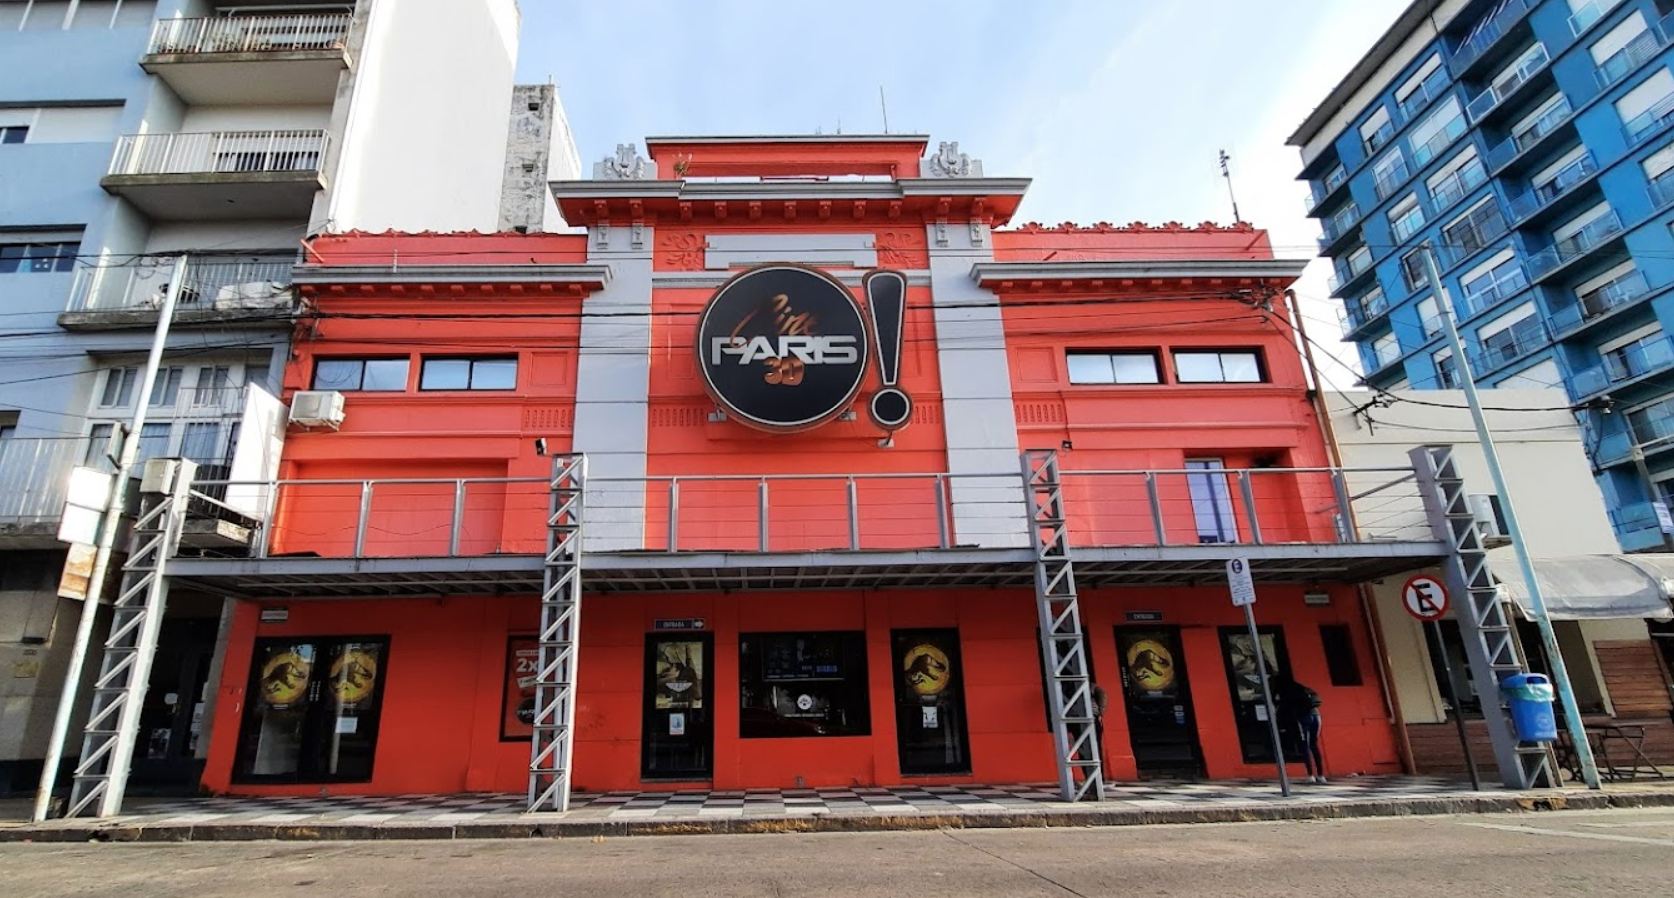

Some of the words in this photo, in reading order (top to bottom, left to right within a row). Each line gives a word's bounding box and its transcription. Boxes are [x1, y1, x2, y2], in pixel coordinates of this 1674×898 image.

[730, 293, 820, 348] Cine
[712, 336, 857, 365] PARIS
[763, 357, 805, 386] 3D
[1413, 582, 1436, 612] E
